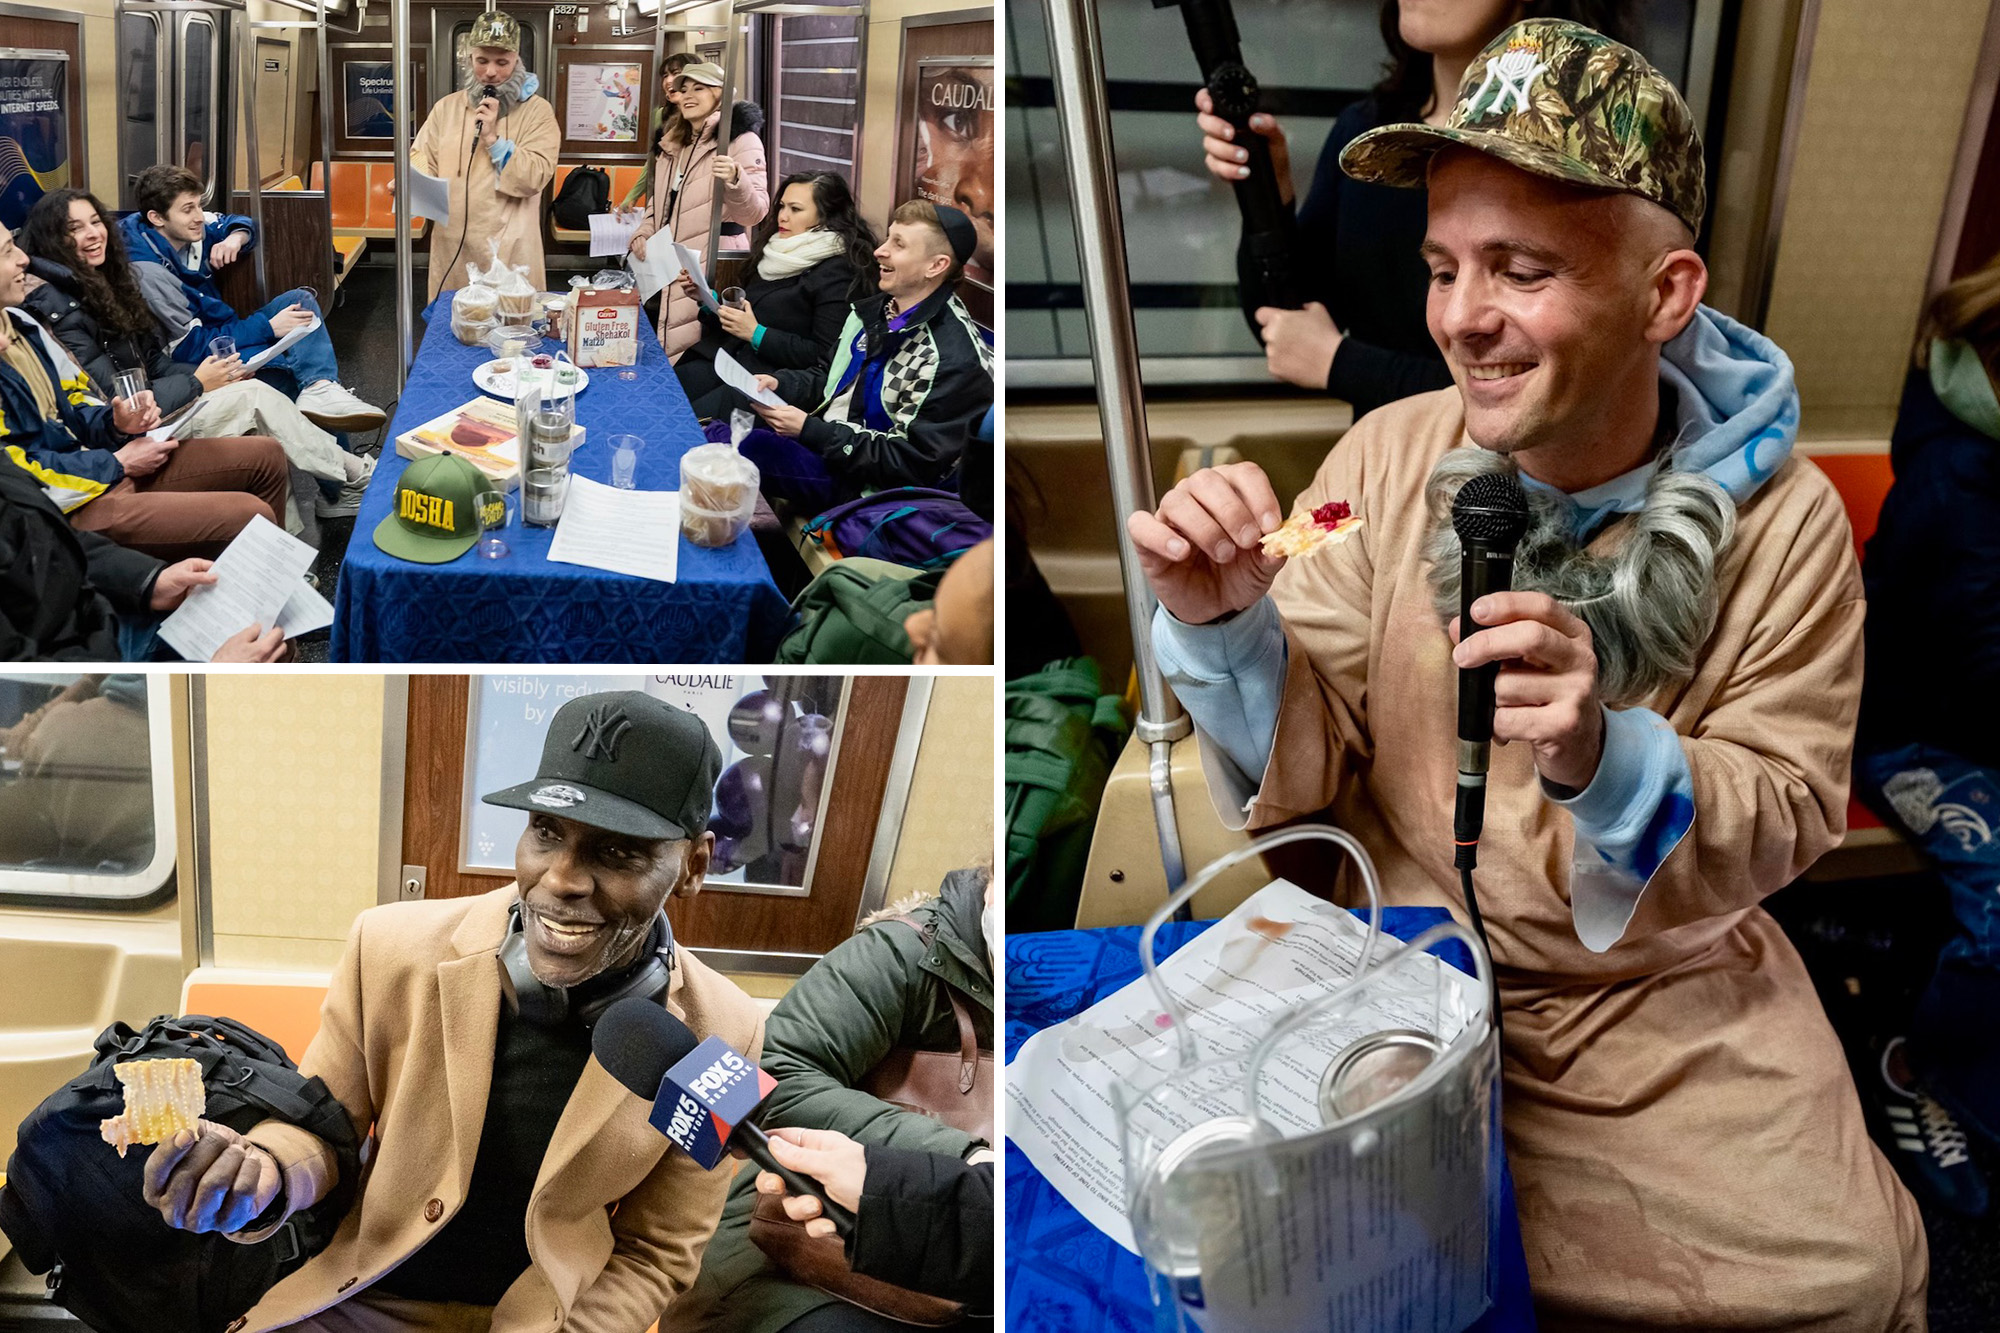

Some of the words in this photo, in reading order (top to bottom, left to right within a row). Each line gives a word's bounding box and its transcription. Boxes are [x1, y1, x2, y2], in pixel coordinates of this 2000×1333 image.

[554, 5, 577, 14] 5827
[14, 76, 43, 87] ENDLESS
[23, 89, 39, 99] WITH
[41, 88, 53, 98] THE
[1, 101, 35, 114] INTERNET
[585, 322, 610, 331] Gluten
[611, 322, 629, 331] Free
[596, 329, 630, 340] Shehakol
[582, 338, 605, 347] Matzo
[533, 443, 544, 455] sh
[491, 676, 550, 700] visibly
[525, 703, 546, 725] by
[707, 1086, 728, 1105] NEW
[728, 1065, 753, 1086] YORK
[684, 1133, 696, 1152] NEW
[692, 1108, 707, 1131] YORK
